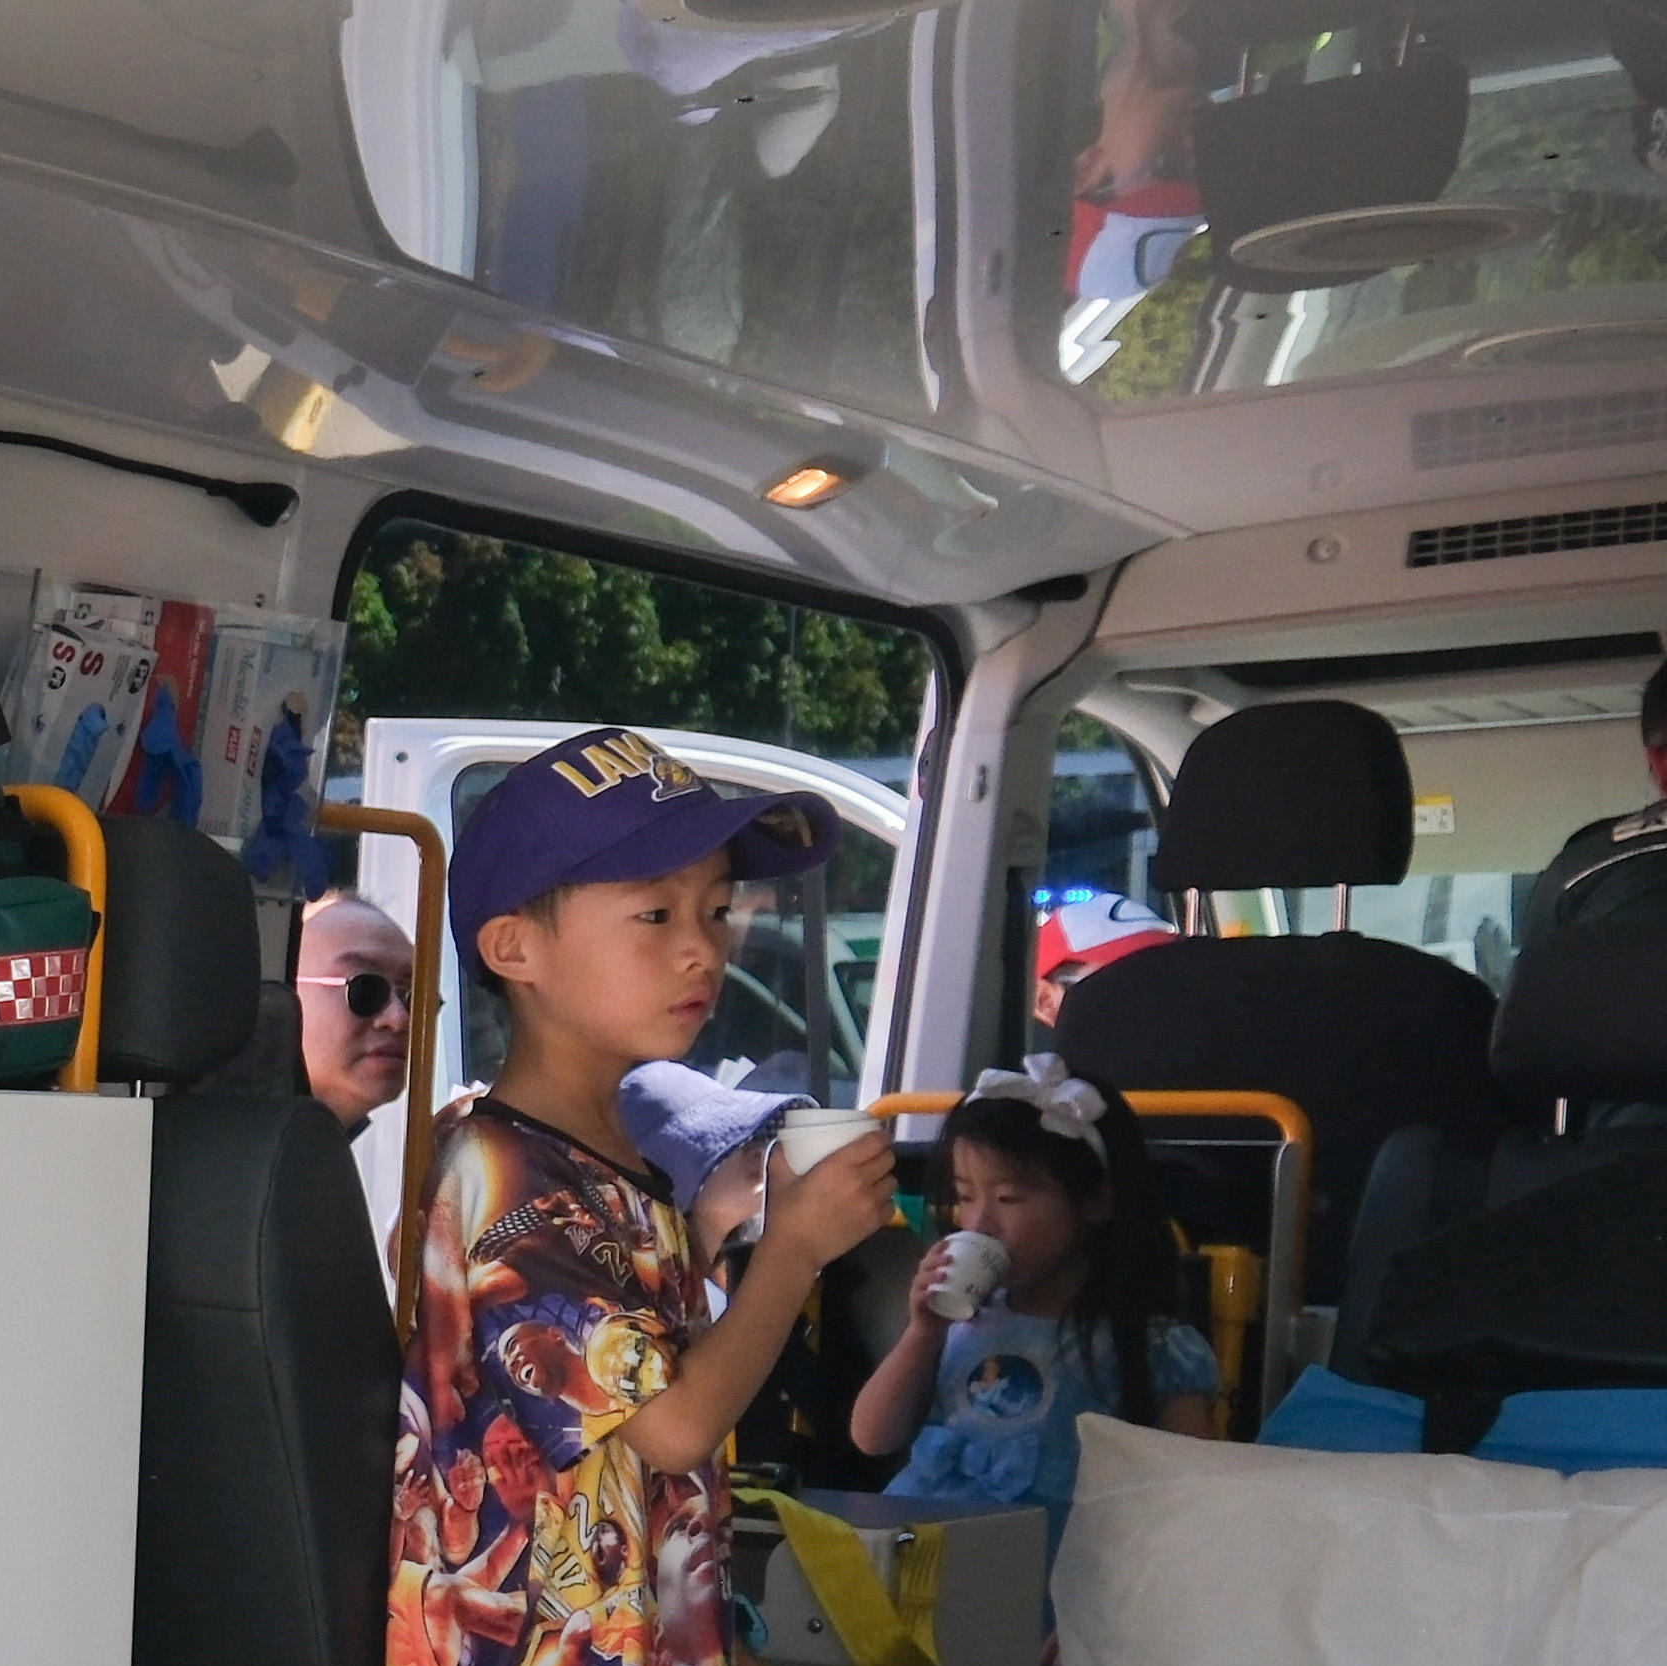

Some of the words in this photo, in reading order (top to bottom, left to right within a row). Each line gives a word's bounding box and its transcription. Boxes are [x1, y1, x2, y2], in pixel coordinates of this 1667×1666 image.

[53, 641, 75, 662] S
[80, 651, 104, 675] S
[552, 732, 657, 798] LAK
